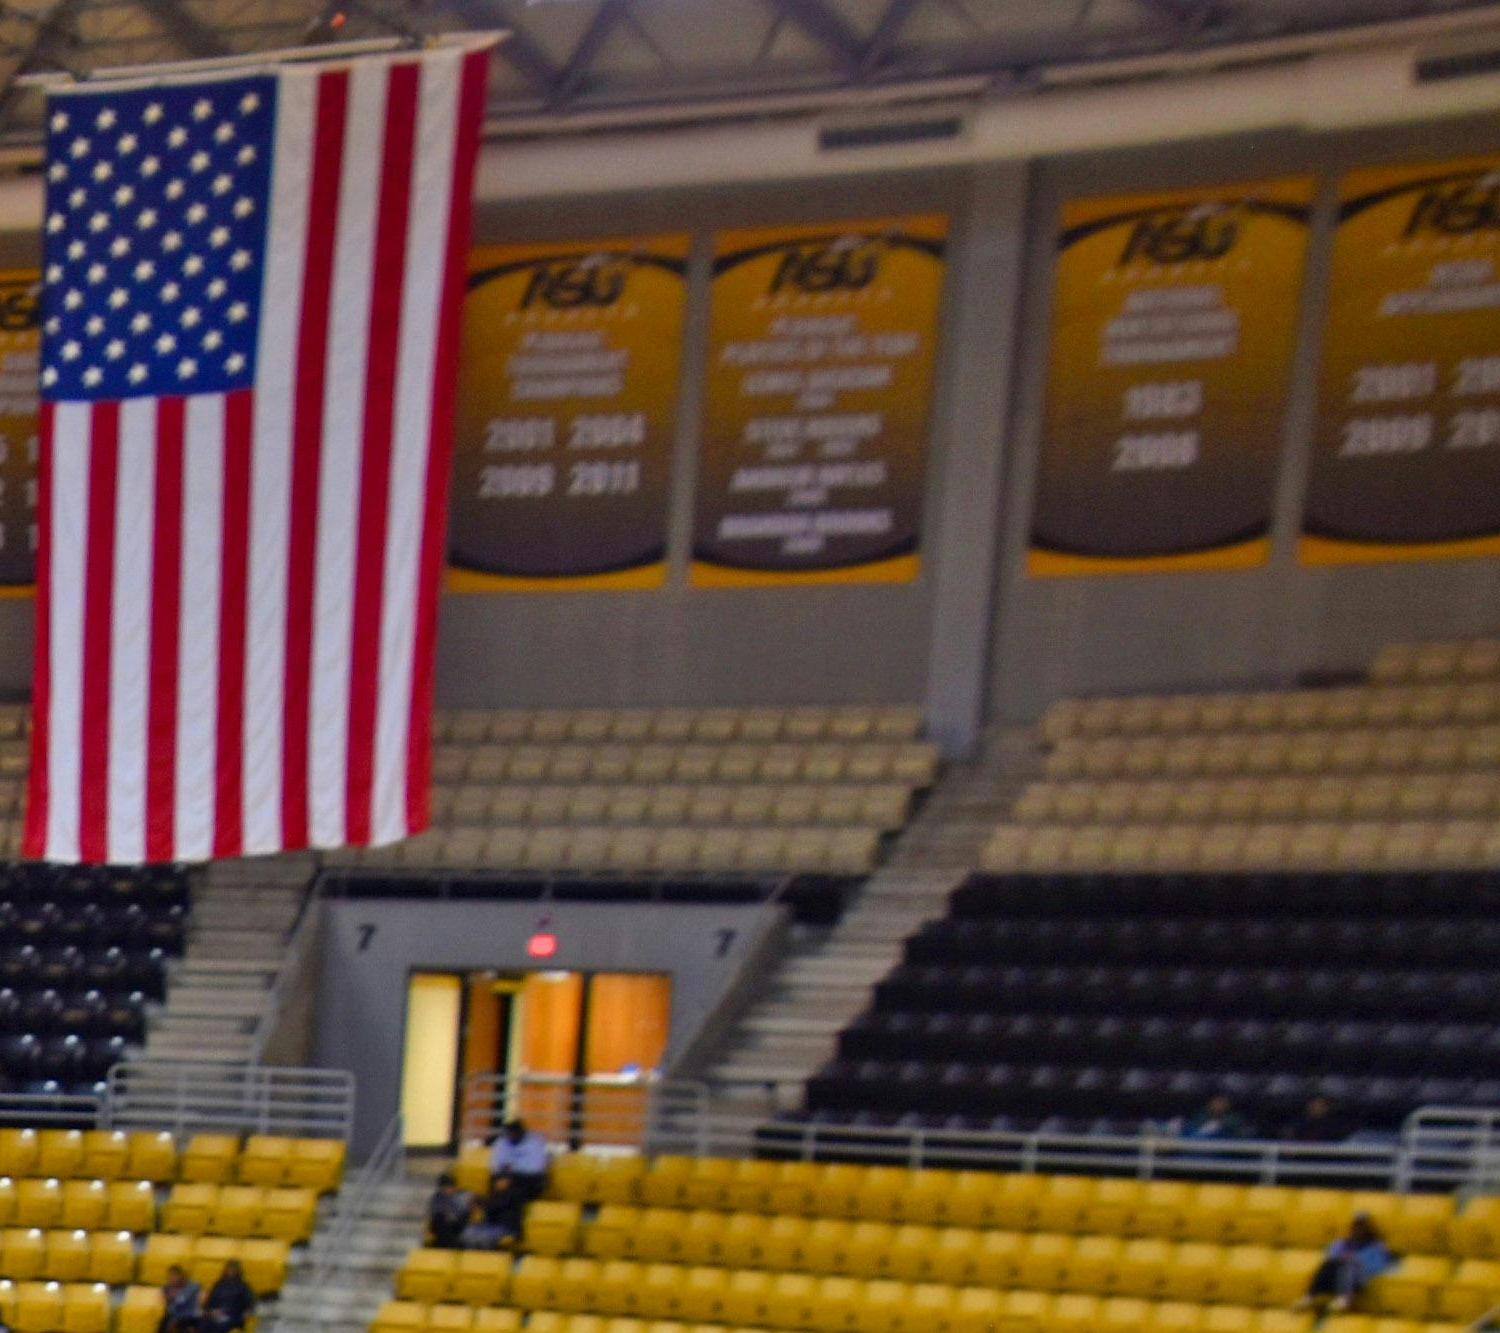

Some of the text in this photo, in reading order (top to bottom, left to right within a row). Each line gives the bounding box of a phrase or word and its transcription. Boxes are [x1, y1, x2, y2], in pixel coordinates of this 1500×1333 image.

[521, 265, 626, 310] ASU
[768, 248, 880, 295] ASU
[355, 924, 377, 952] 7
[713, 928, 737, 956] 7
